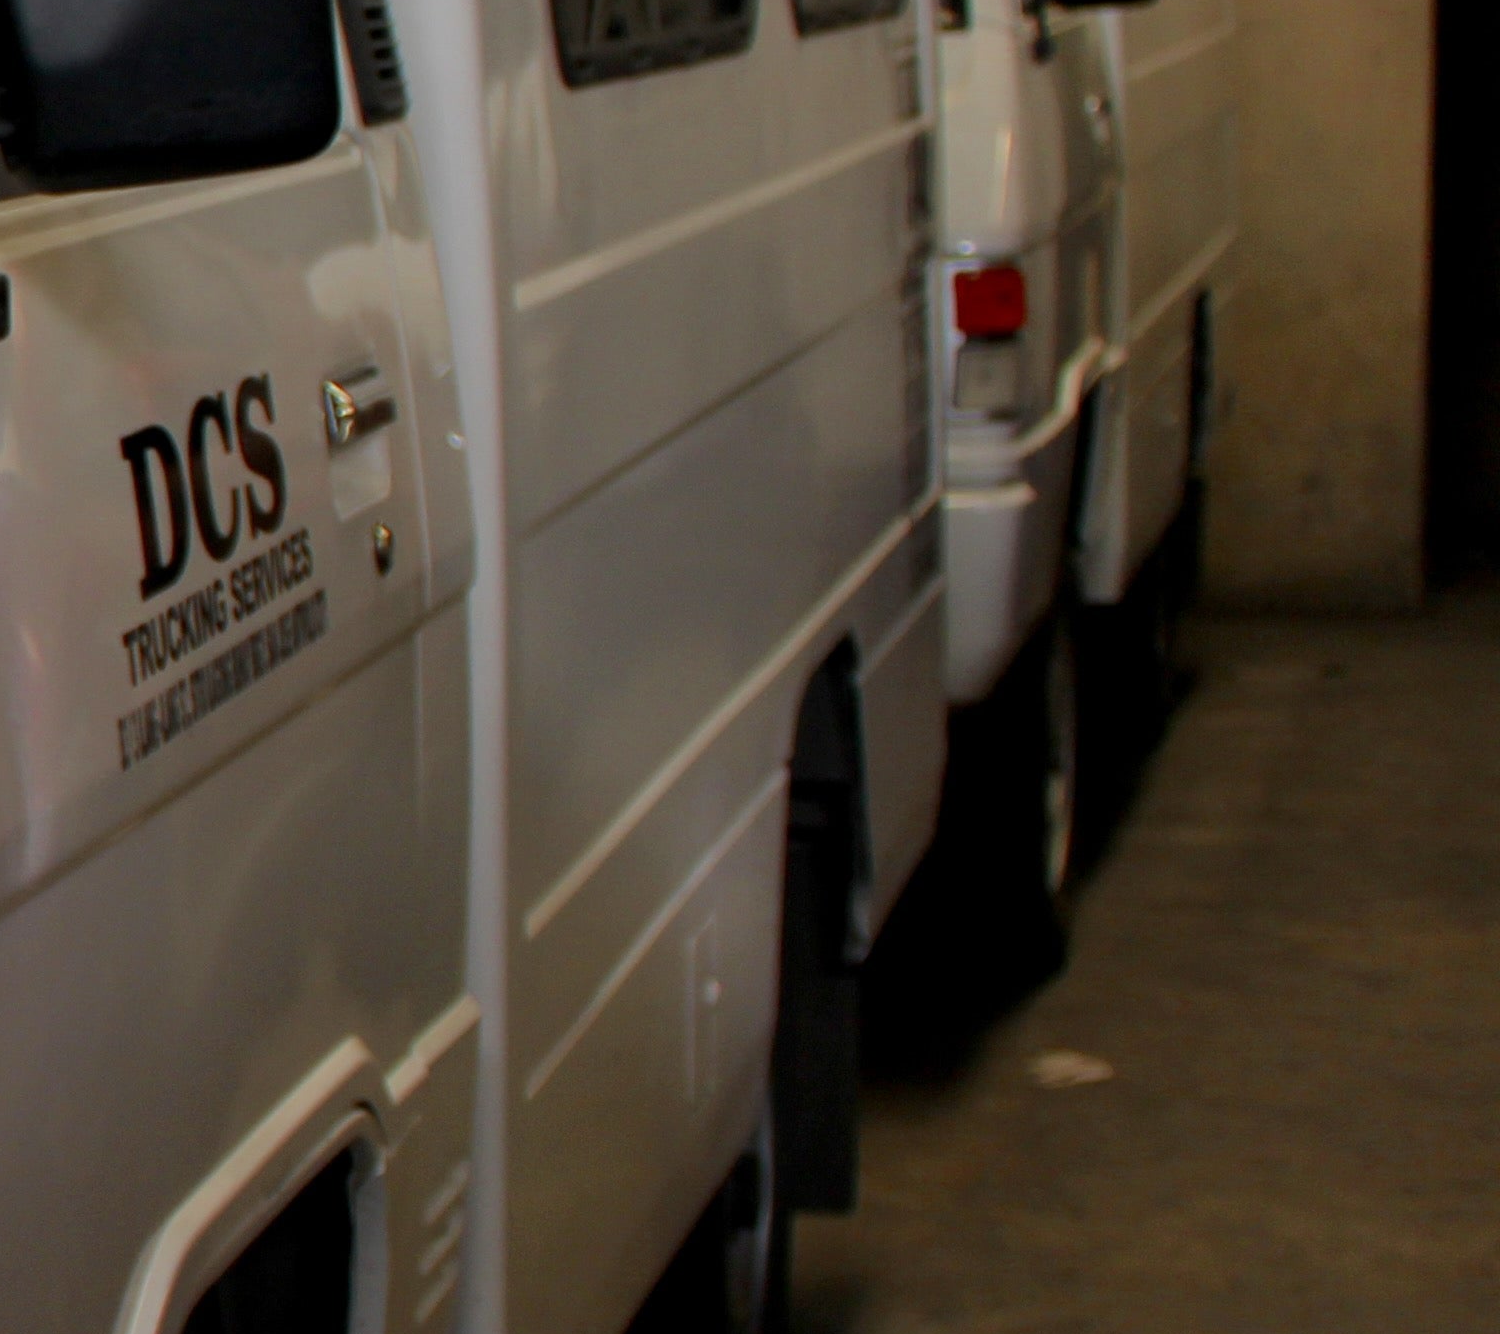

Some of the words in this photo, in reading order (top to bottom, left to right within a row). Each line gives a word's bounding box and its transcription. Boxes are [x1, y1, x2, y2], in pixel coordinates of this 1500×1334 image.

[119, 370, 288, 603] DCS
[121, 577, 230, 688] TRUCKING
[229, 527, 315, 624] SERVICES
